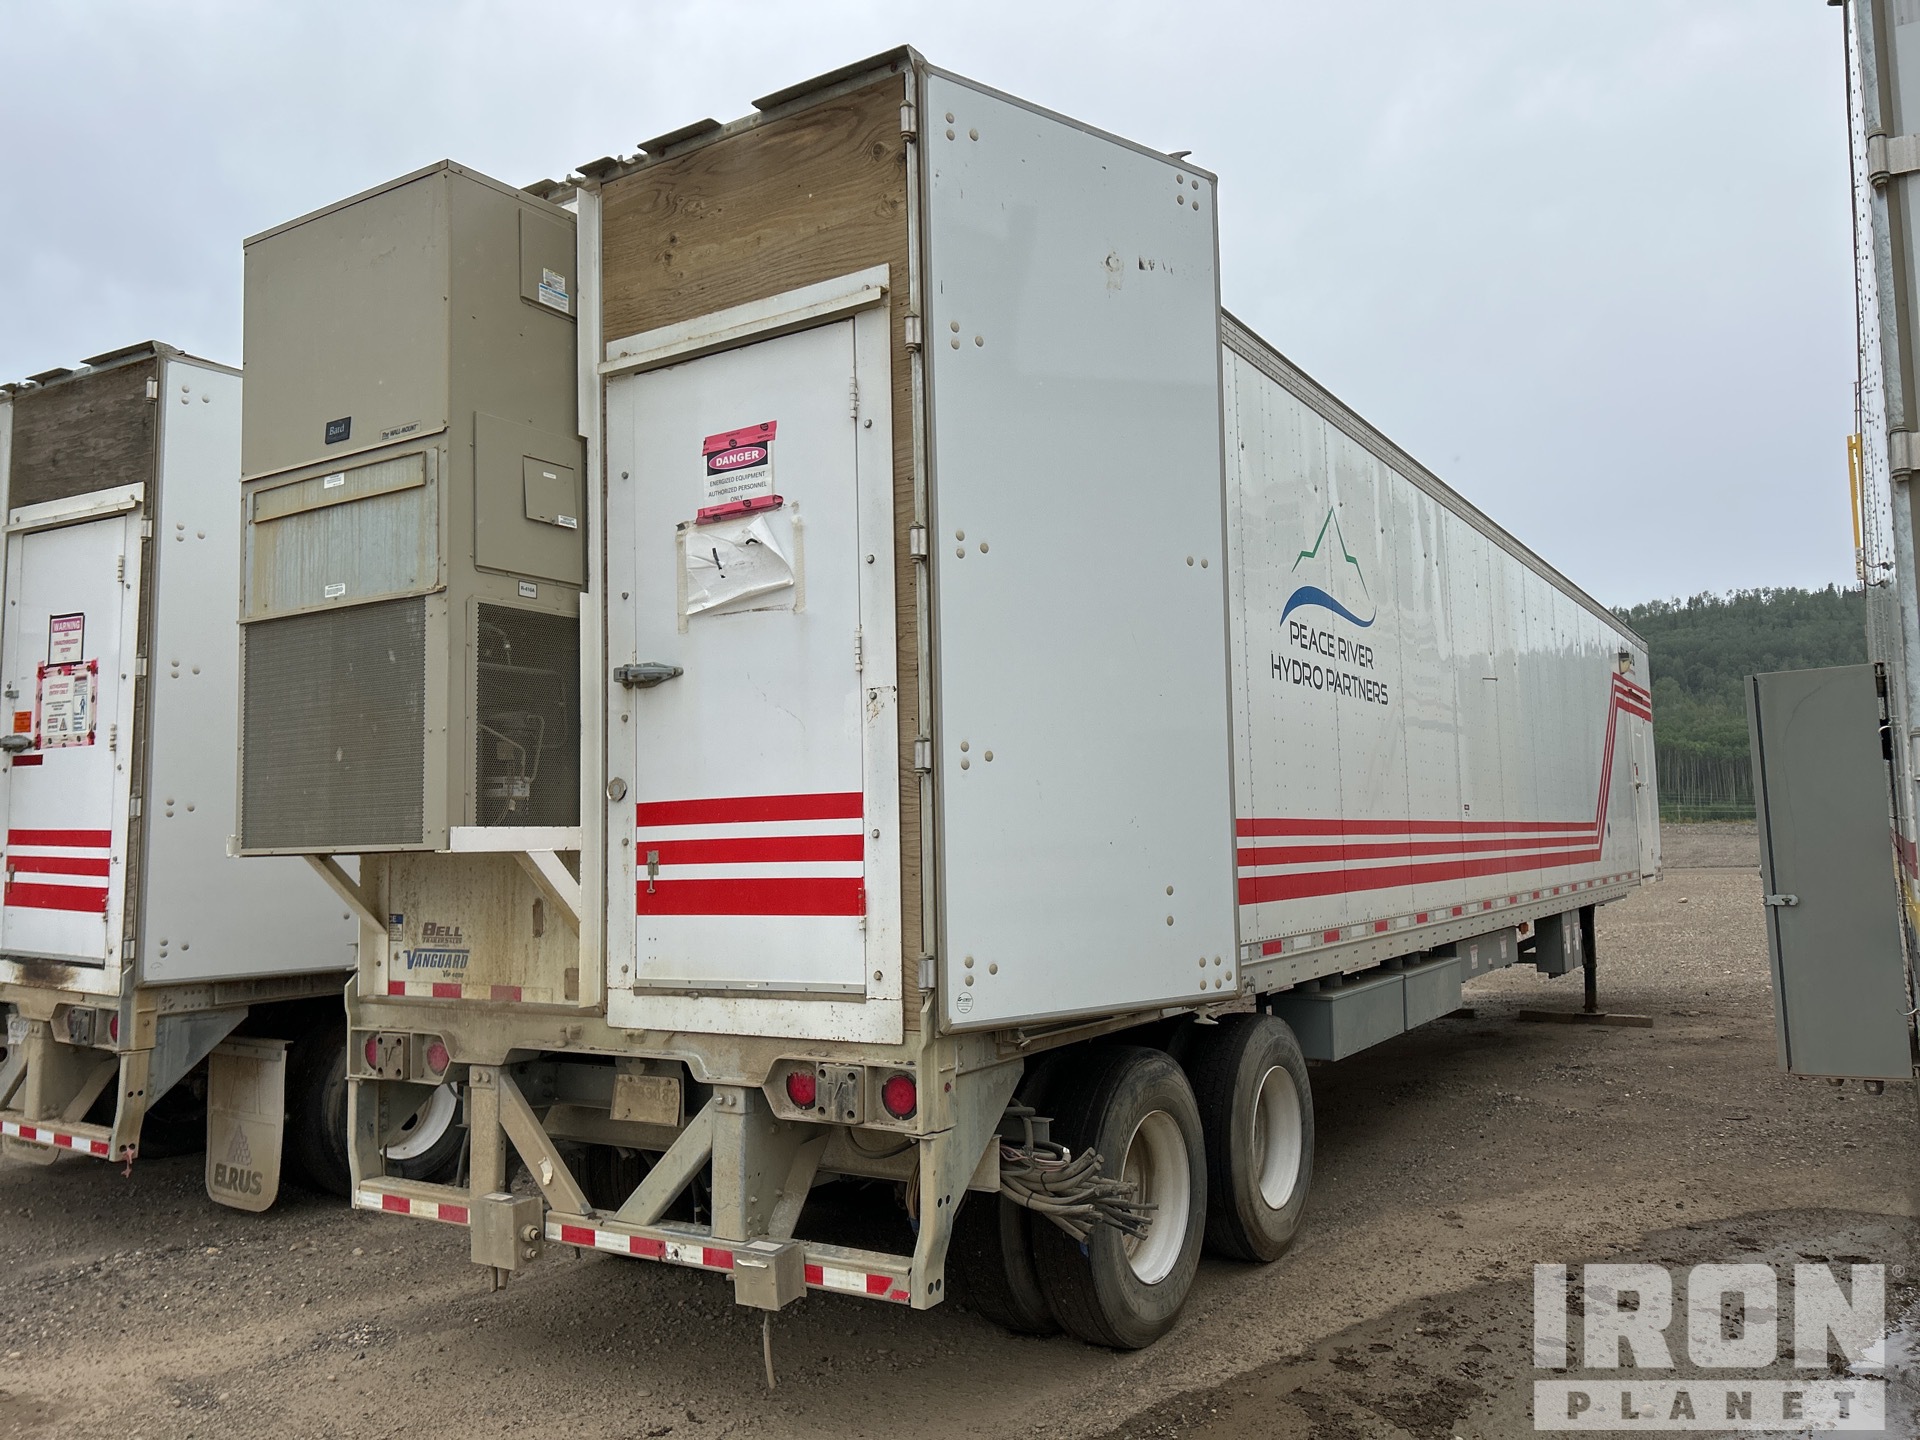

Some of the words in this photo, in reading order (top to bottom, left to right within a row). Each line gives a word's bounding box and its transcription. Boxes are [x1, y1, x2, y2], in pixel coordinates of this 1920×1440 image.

[328, 424, 345, 436] Bard
[716, 450, 759, 466] DANGER
[709, 477, 735, 487] ENERGIZED
[736, 471, 765, 481] EQUIPMENT
[708, 487, 737, 497] AUTHORIZED
[738, 481, 767, 491] PERSONNEL
[730, 494, 744, 502] ONLY
[53, 620, 80, 631] WARNING
[1289, 620, 1335, 658] PEACE
[1337, 636, 1374, 670] RIVER
[1270, 653, 1324, 690] HYDRO
[1326, 667, 1389, 706] PARTNERS
[422, 922, 463, 937] BELL
[403, 948, 470, 970] VANGUARD
[214, 1162, 263, 1196] ELRUS
